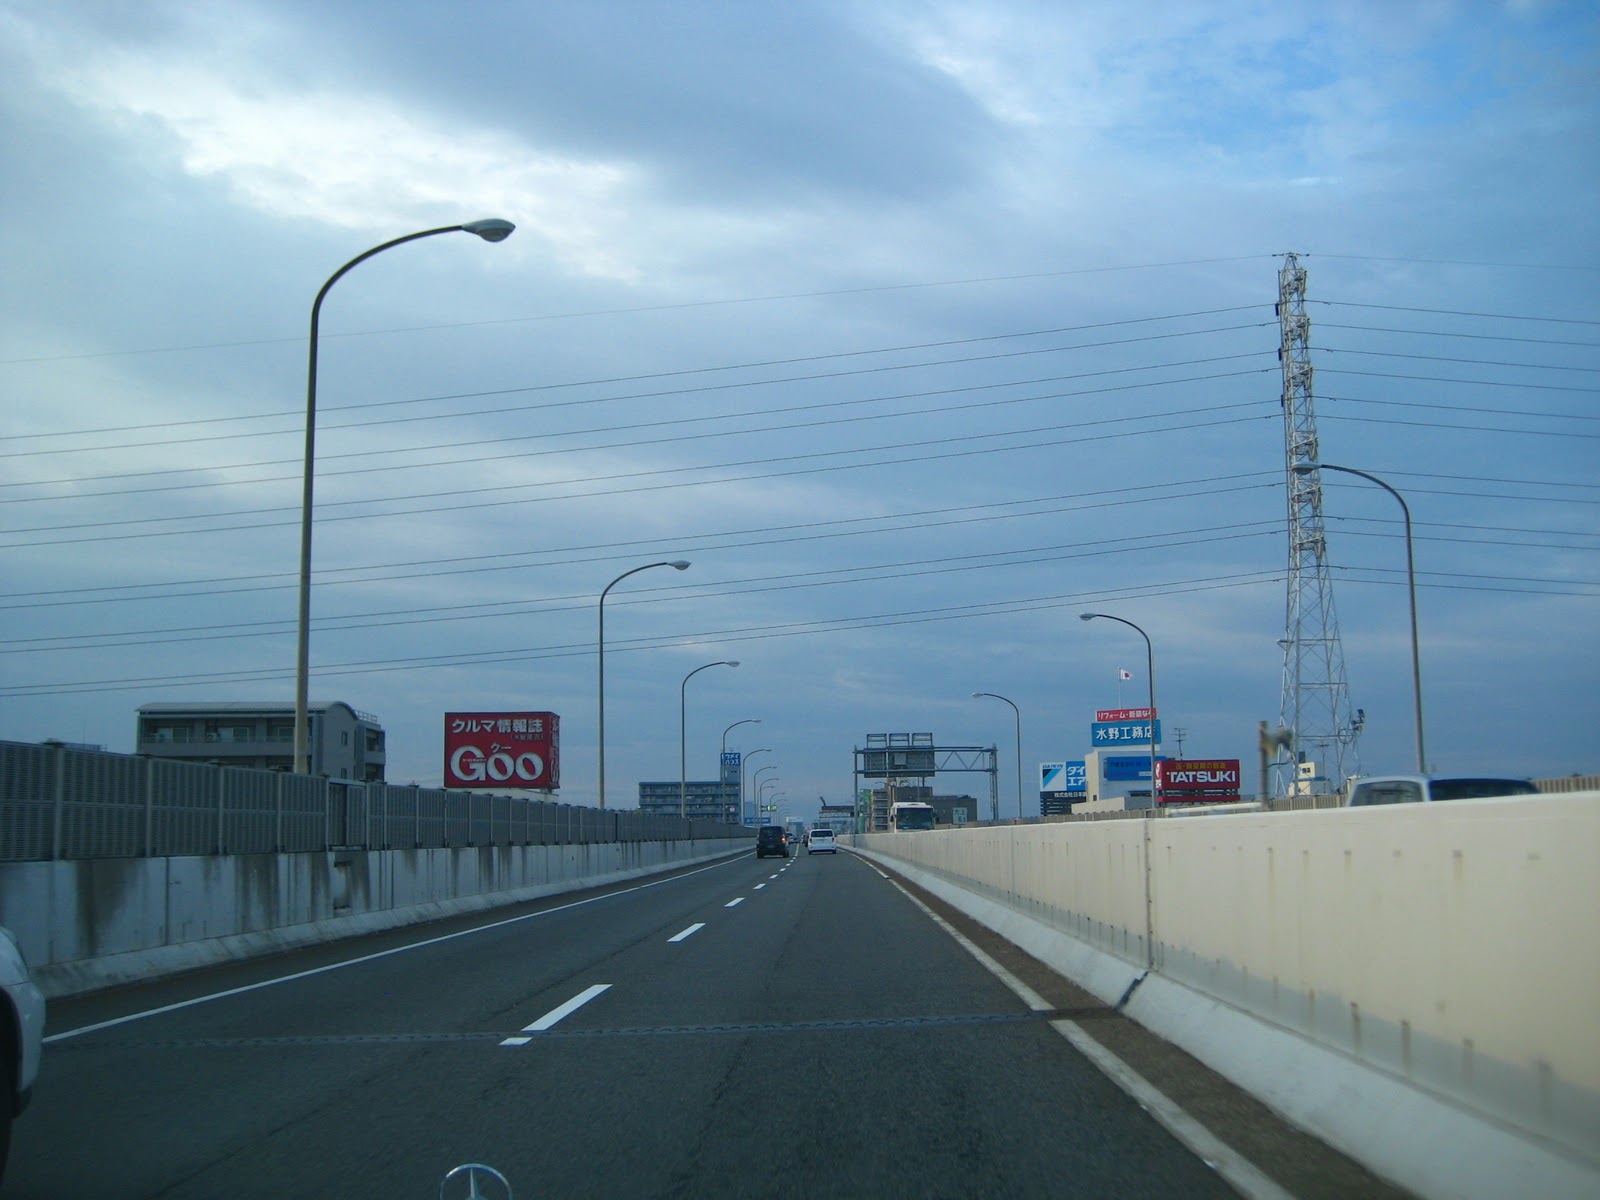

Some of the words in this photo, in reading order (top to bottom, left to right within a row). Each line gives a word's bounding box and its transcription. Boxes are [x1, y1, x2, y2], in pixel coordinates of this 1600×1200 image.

[452, 719, 542, 733] クルマ情報誌
[1096, 726, 1155, 740] 水野工務店
[450, 745, 544, 781] Goo
[1169, 771, 1236, 783] TATSUKI
